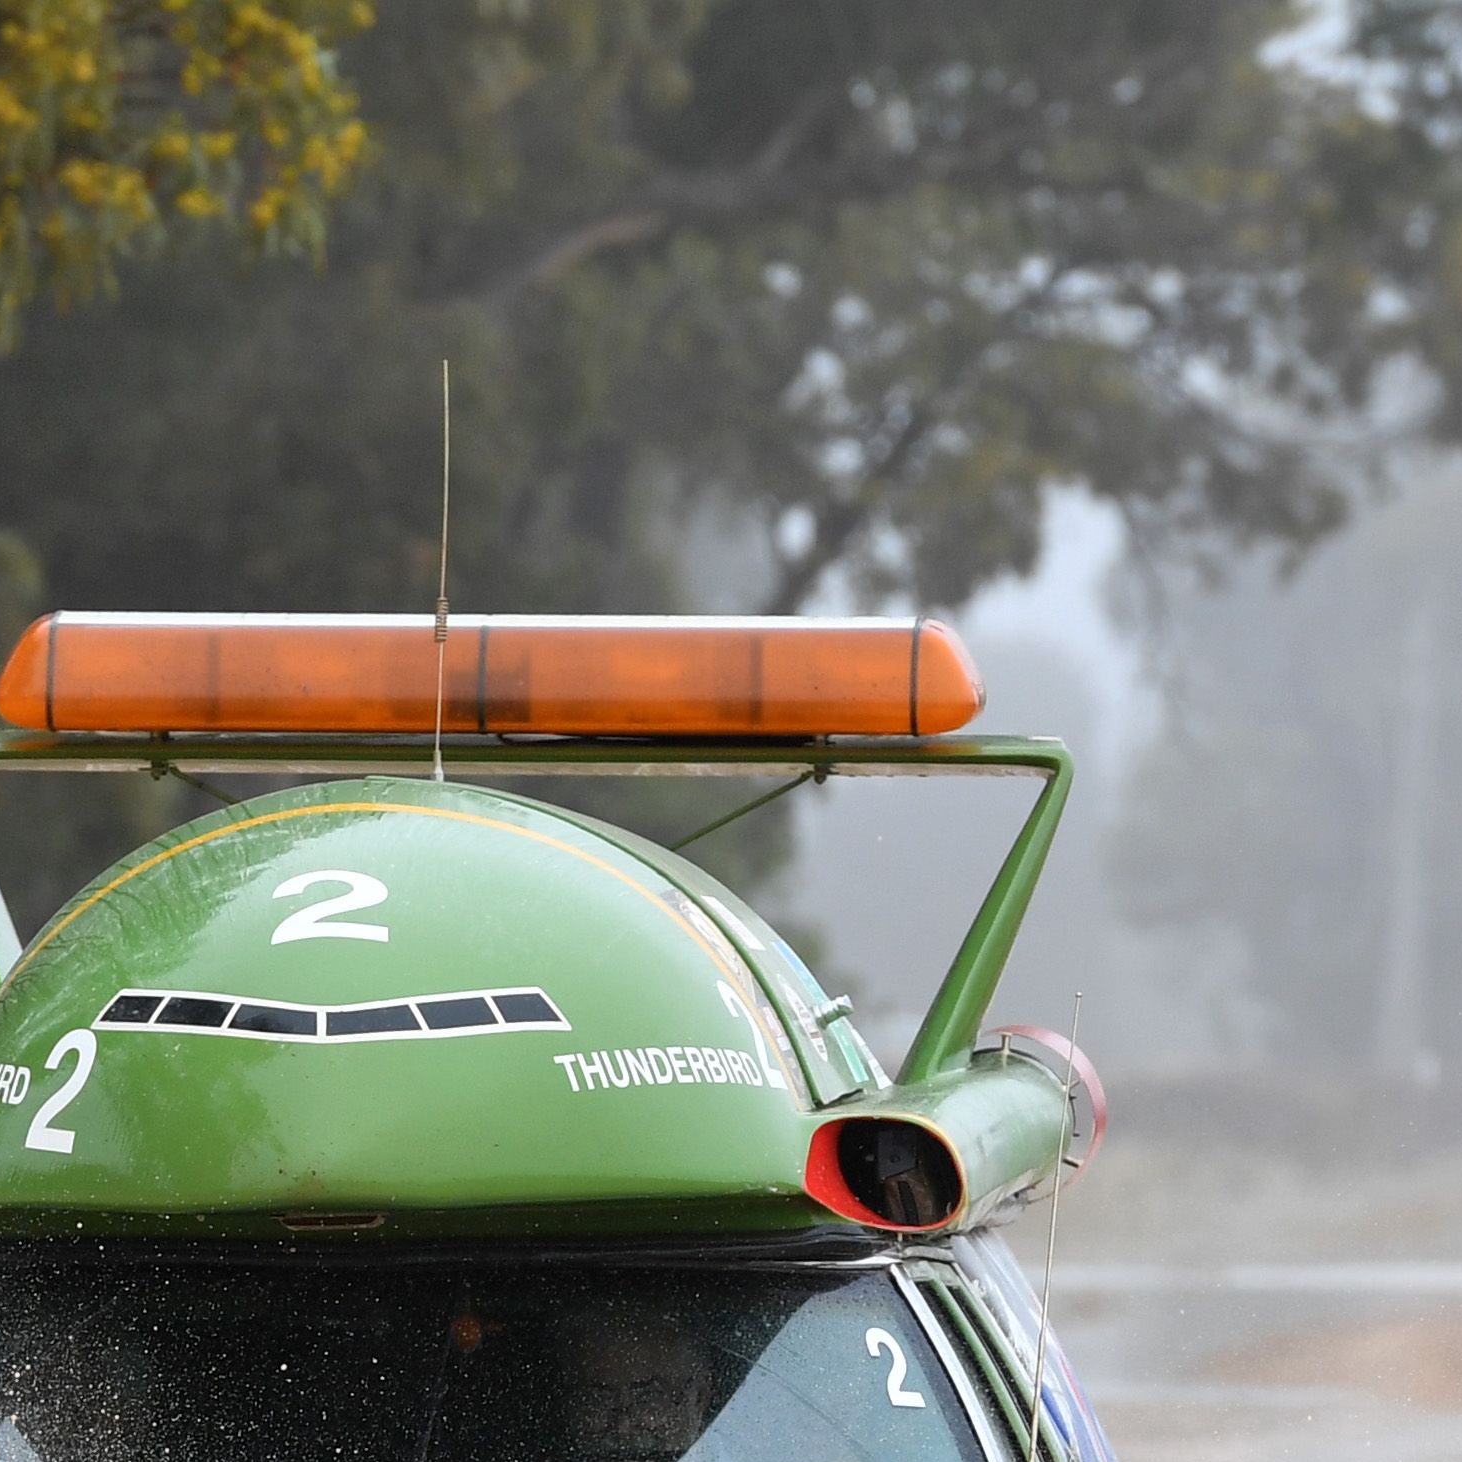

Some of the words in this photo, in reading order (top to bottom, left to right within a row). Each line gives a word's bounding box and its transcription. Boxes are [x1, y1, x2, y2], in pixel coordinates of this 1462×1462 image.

[270, 869, 389, 945] 2
[553, 1046, 764, 1092] THUNDERBIRD
[716, 979, 789, 1091] 2
[25, 1028, 98, 1154] 2
[865, 1327, 927, 1408] 2
